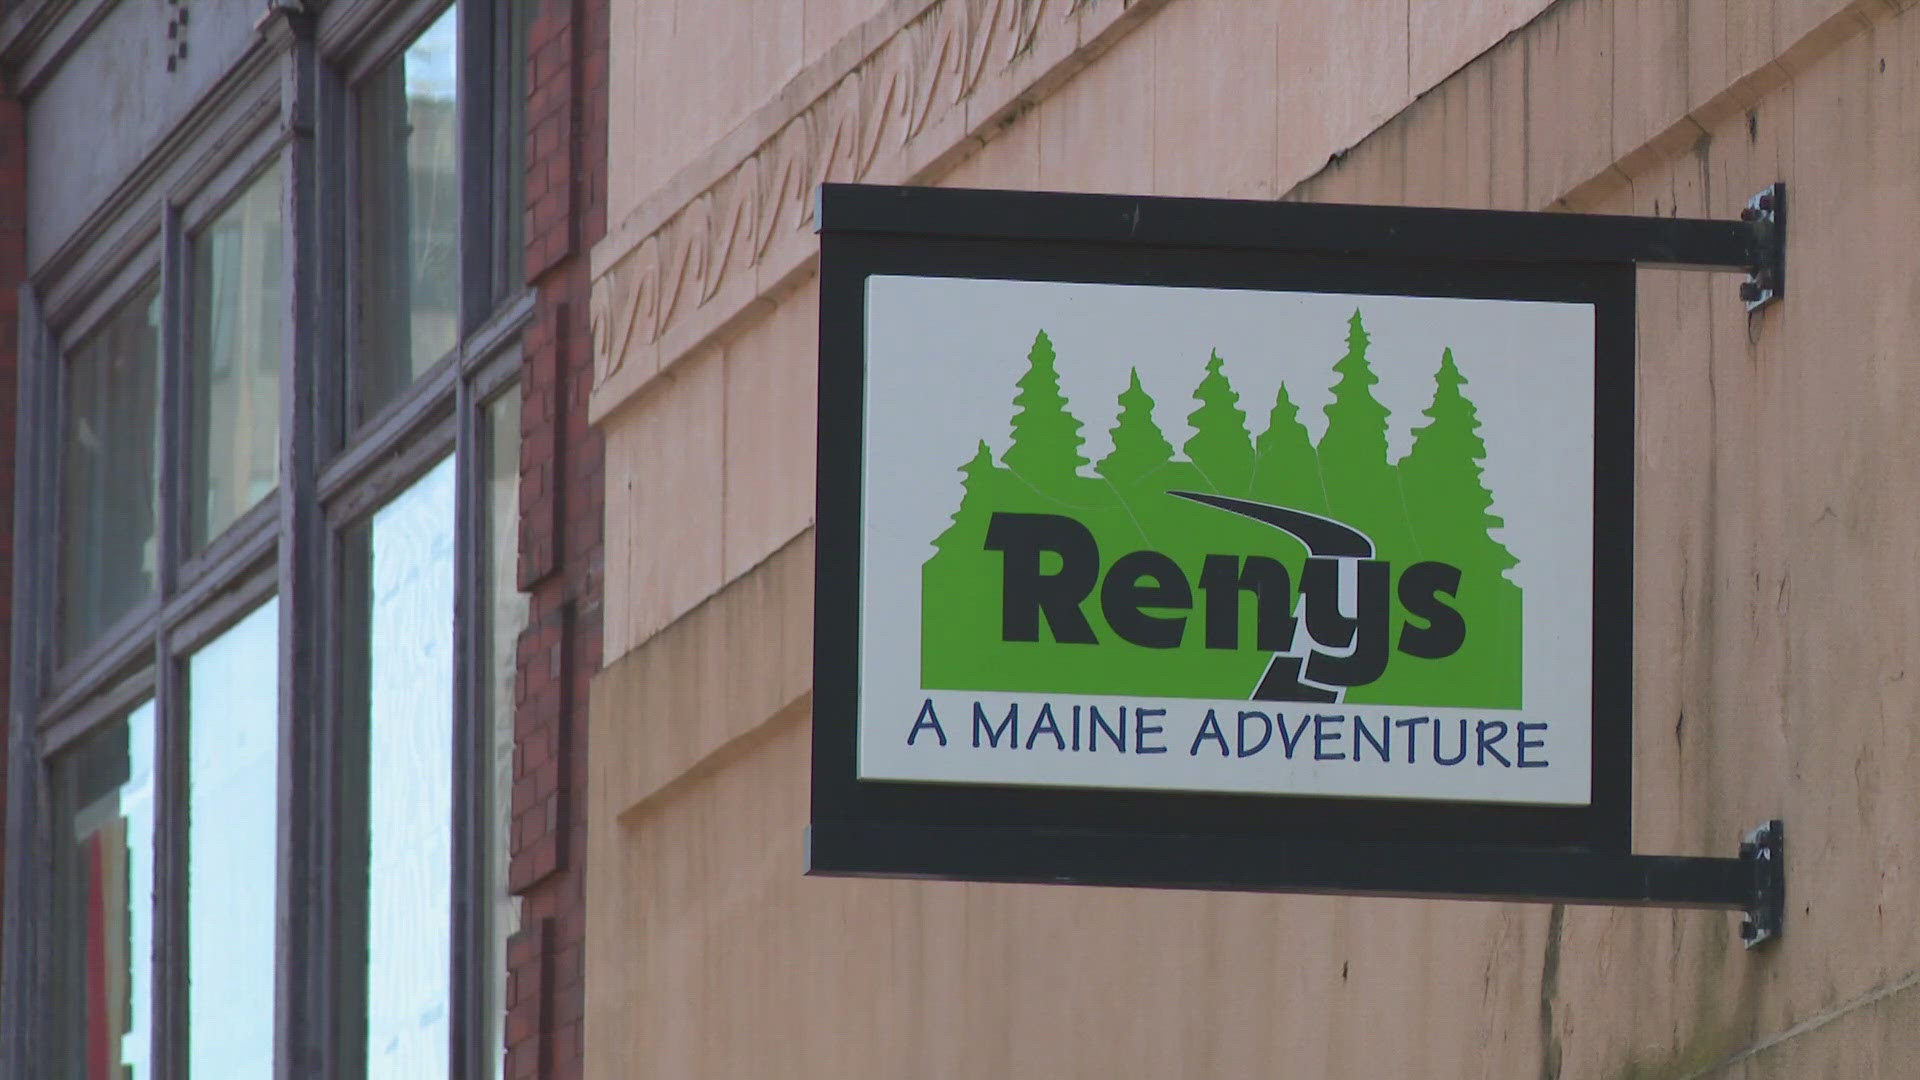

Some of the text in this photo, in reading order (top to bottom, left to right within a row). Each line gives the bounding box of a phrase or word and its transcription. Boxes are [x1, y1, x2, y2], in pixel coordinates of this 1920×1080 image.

[983, 511, 1467, 687] Renys
[907, 698, 1550, 769] A MAINE ADVENTURE
